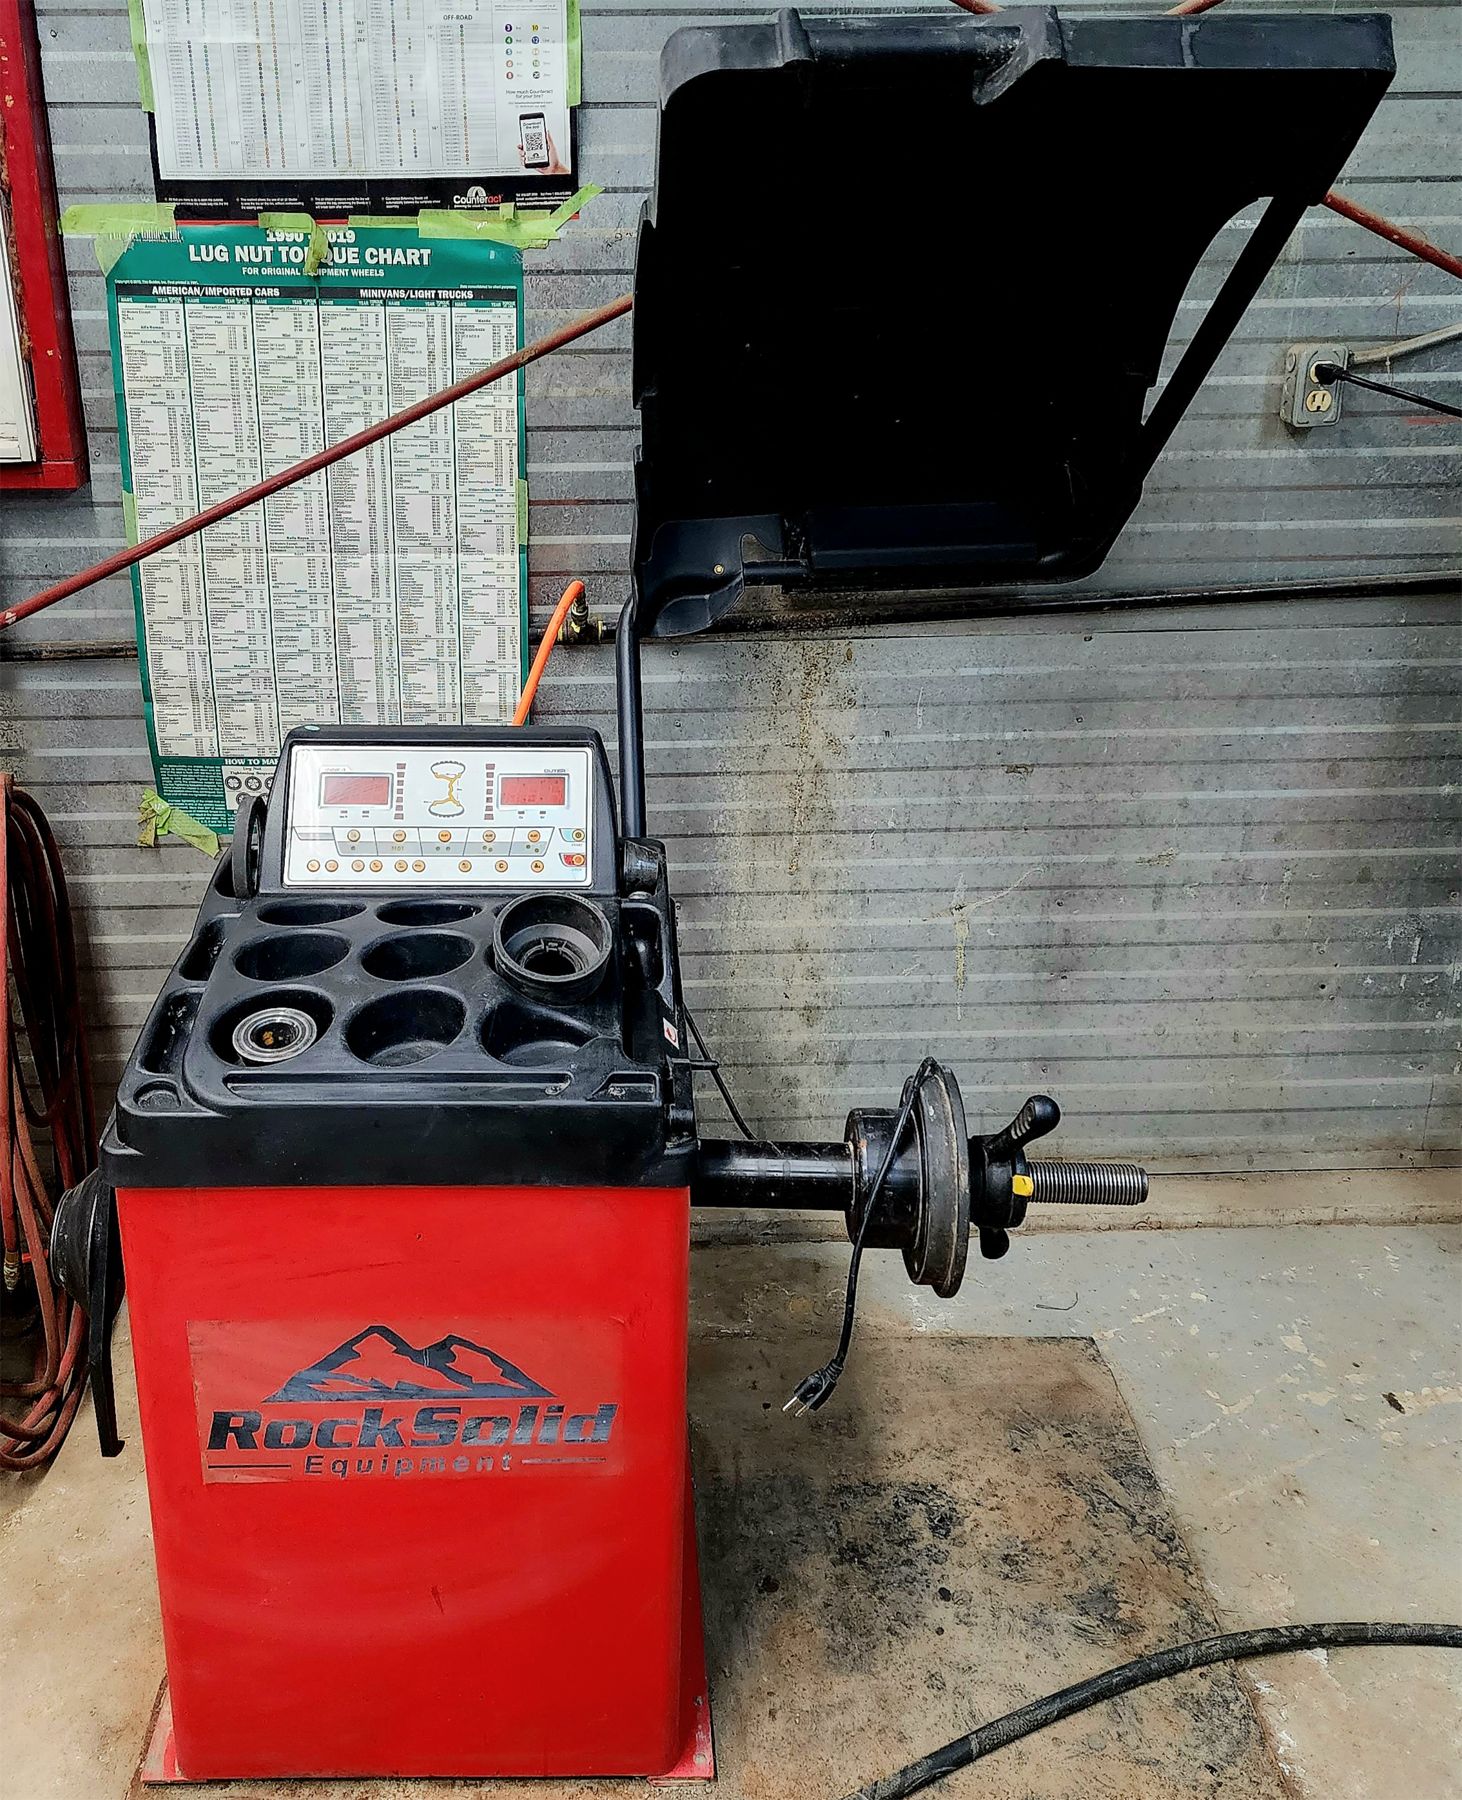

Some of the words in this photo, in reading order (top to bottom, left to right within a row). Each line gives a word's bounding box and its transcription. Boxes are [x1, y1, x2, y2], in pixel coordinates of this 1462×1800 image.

[453, 195, 502, 204] Counteract
[266, 229, 304, 242] 1990
[327, 230, 356, 243] 019
[188, 244, 230, 263] LUG
[234, 245, 274, 263] NUT
[365, 247, 432, 265] CHART
[242, 267, 259, 275] FOR
[261, 267, 301, 276] ORIGINAL
[351, 268, 385, 277] WHEELS
[152, 286, 252, 297] AMERICAN/IMPORTED
[255, 287, 280, 296] CARS
[360, 289, 436, 300] MINIVANS/LIGHT
[438, 290, 474, 299] TRUCKS
[207, 1403, 618, 1451] RockSolid
[304, 1452, 513, 1479] Equipment
